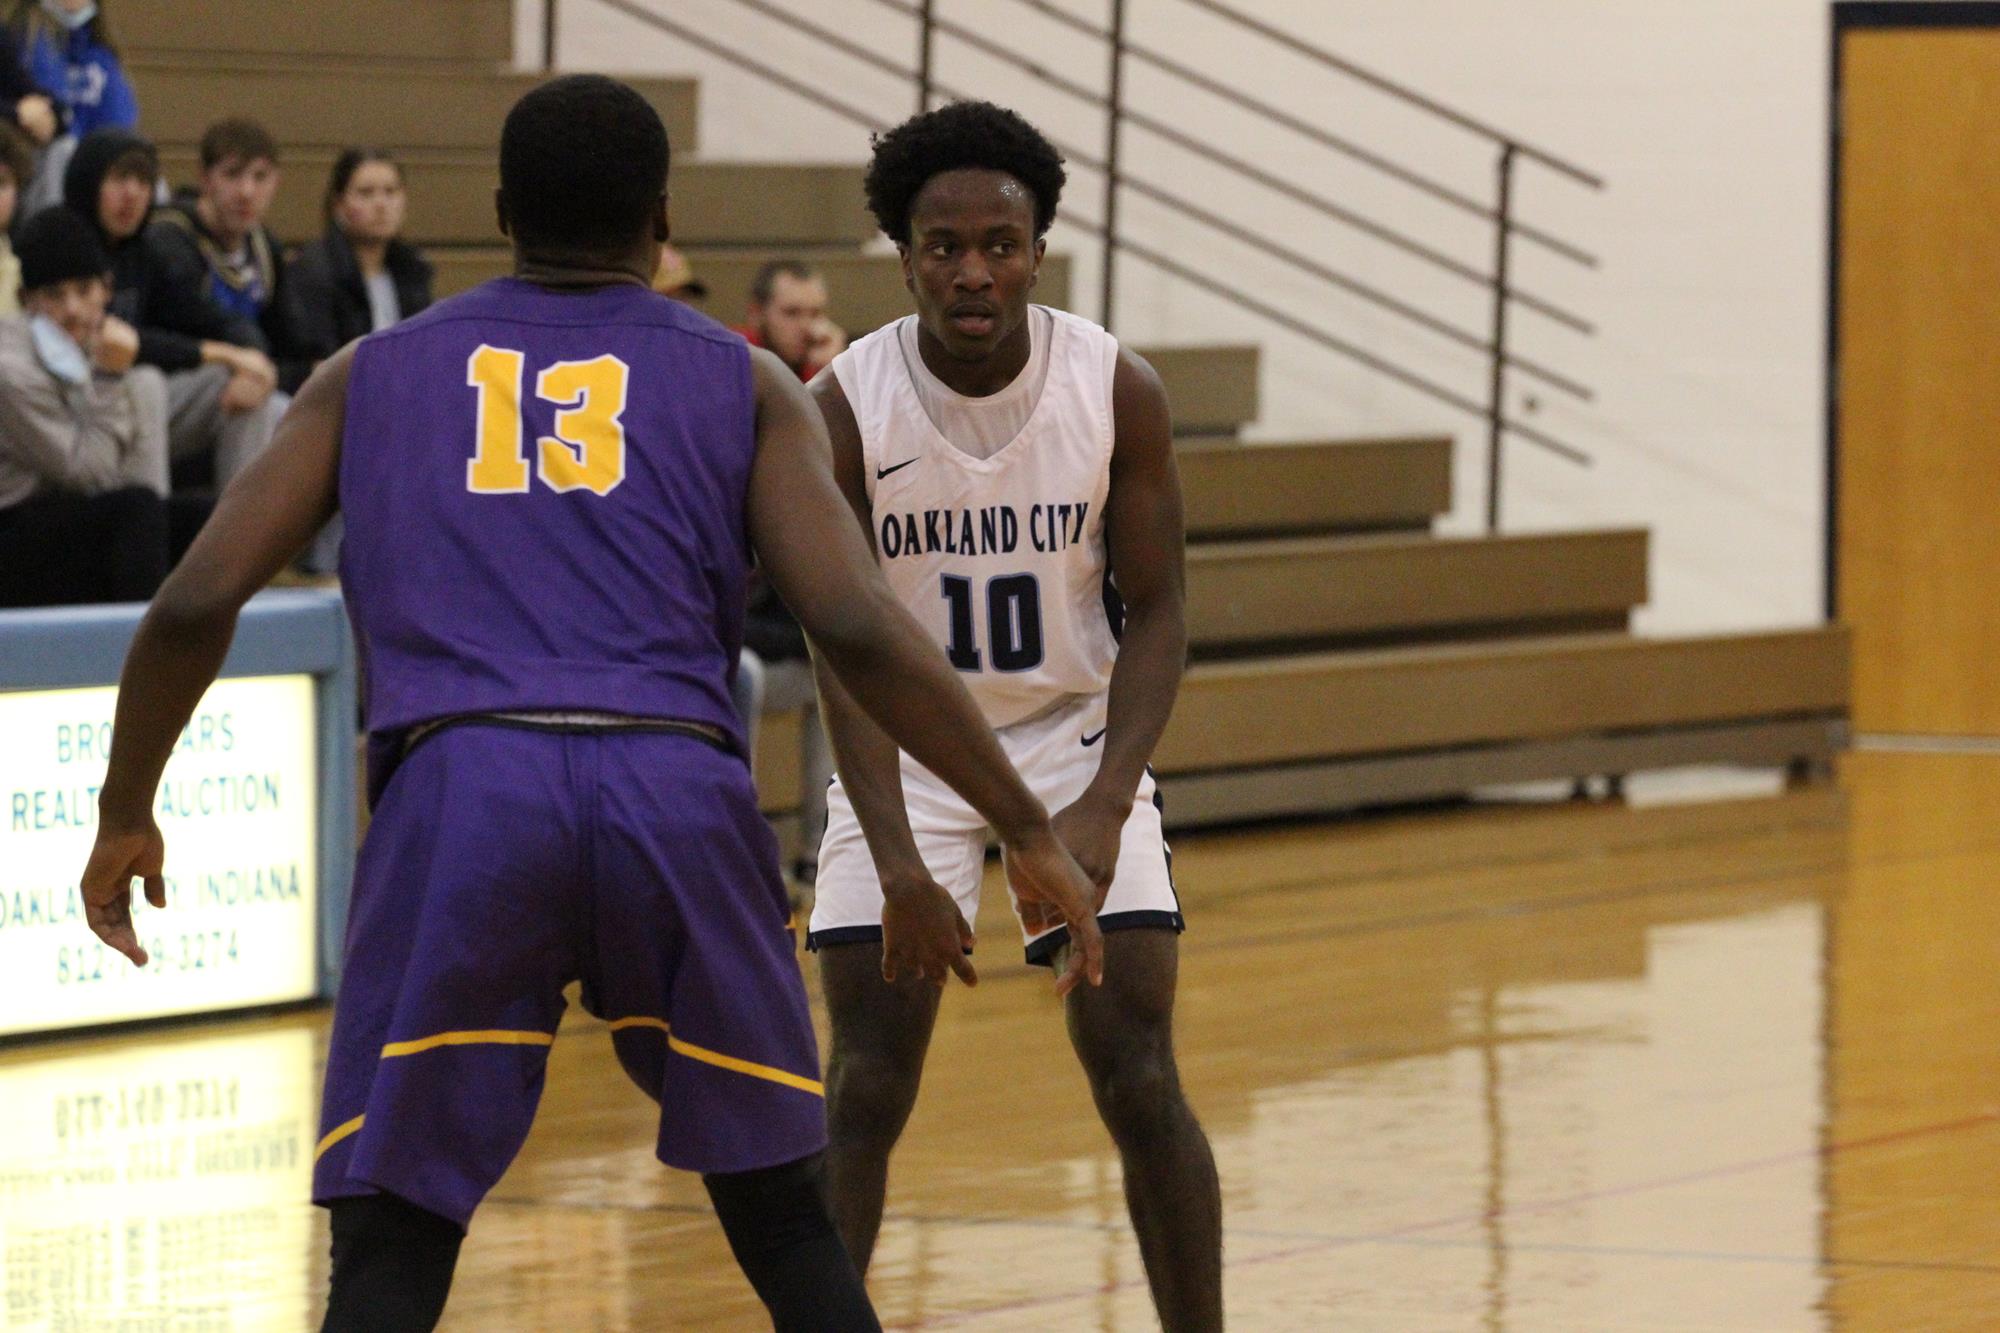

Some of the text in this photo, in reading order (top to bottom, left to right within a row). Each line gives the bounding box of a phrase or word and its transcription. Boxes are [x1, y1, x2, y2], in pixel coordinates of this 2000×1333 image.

[466, 343, 630, 497] 13
[881, 502, 1089, 559] OAKLAND CITY
[940, 571, 1045, 674] 10
[57, 713, 234, 764] BROARS
[11, 773, 281, 832] REALT AUCTION
[0, 886, 83, 928] AKLA
